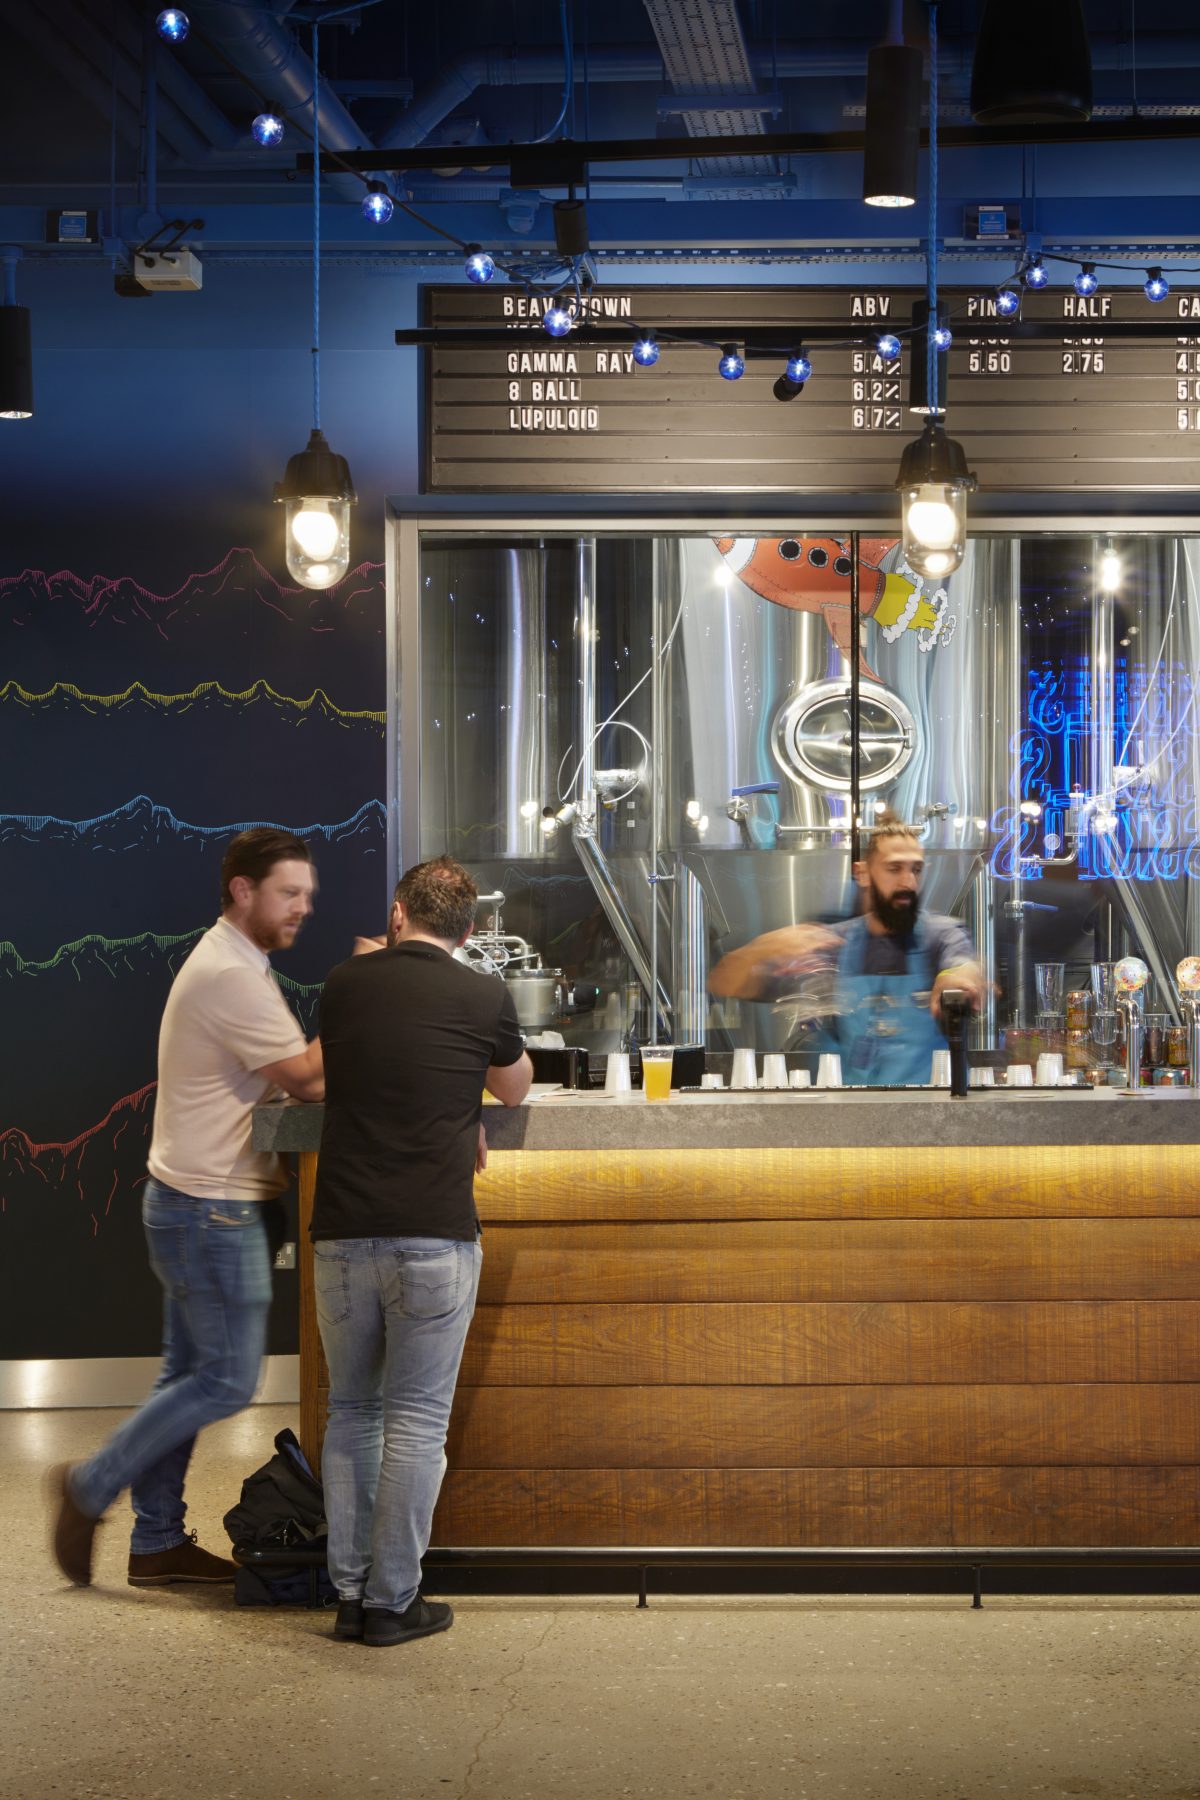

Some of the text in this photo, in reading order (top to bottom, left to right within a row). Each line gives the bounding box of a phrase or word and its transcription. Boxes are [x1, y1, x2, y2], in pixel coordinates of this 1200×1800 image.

[503, 296, 632, 317] BEAVRTOWN
[852, 297, 890, 317] ABV
[967, 297, 1009, 317] PIN
[1063, 297, 1111, 317] HALF
[507, 353, 578, 373] GAMMA
[596, 353, 634, 373] RAY
[853, 353, 901, 375] 5.4%
[969, 353, 1010, 372] 5.50
[1063, 353, 1104, 373] 2.75
[508, 381, 520, 401] 8
[532, 381, 580, 401] BALL
[853, 382, 899, 401] 6.2%
[510, 408, 598, 429] LUPULOID
[853, 408, 900, 428] 6.7%
